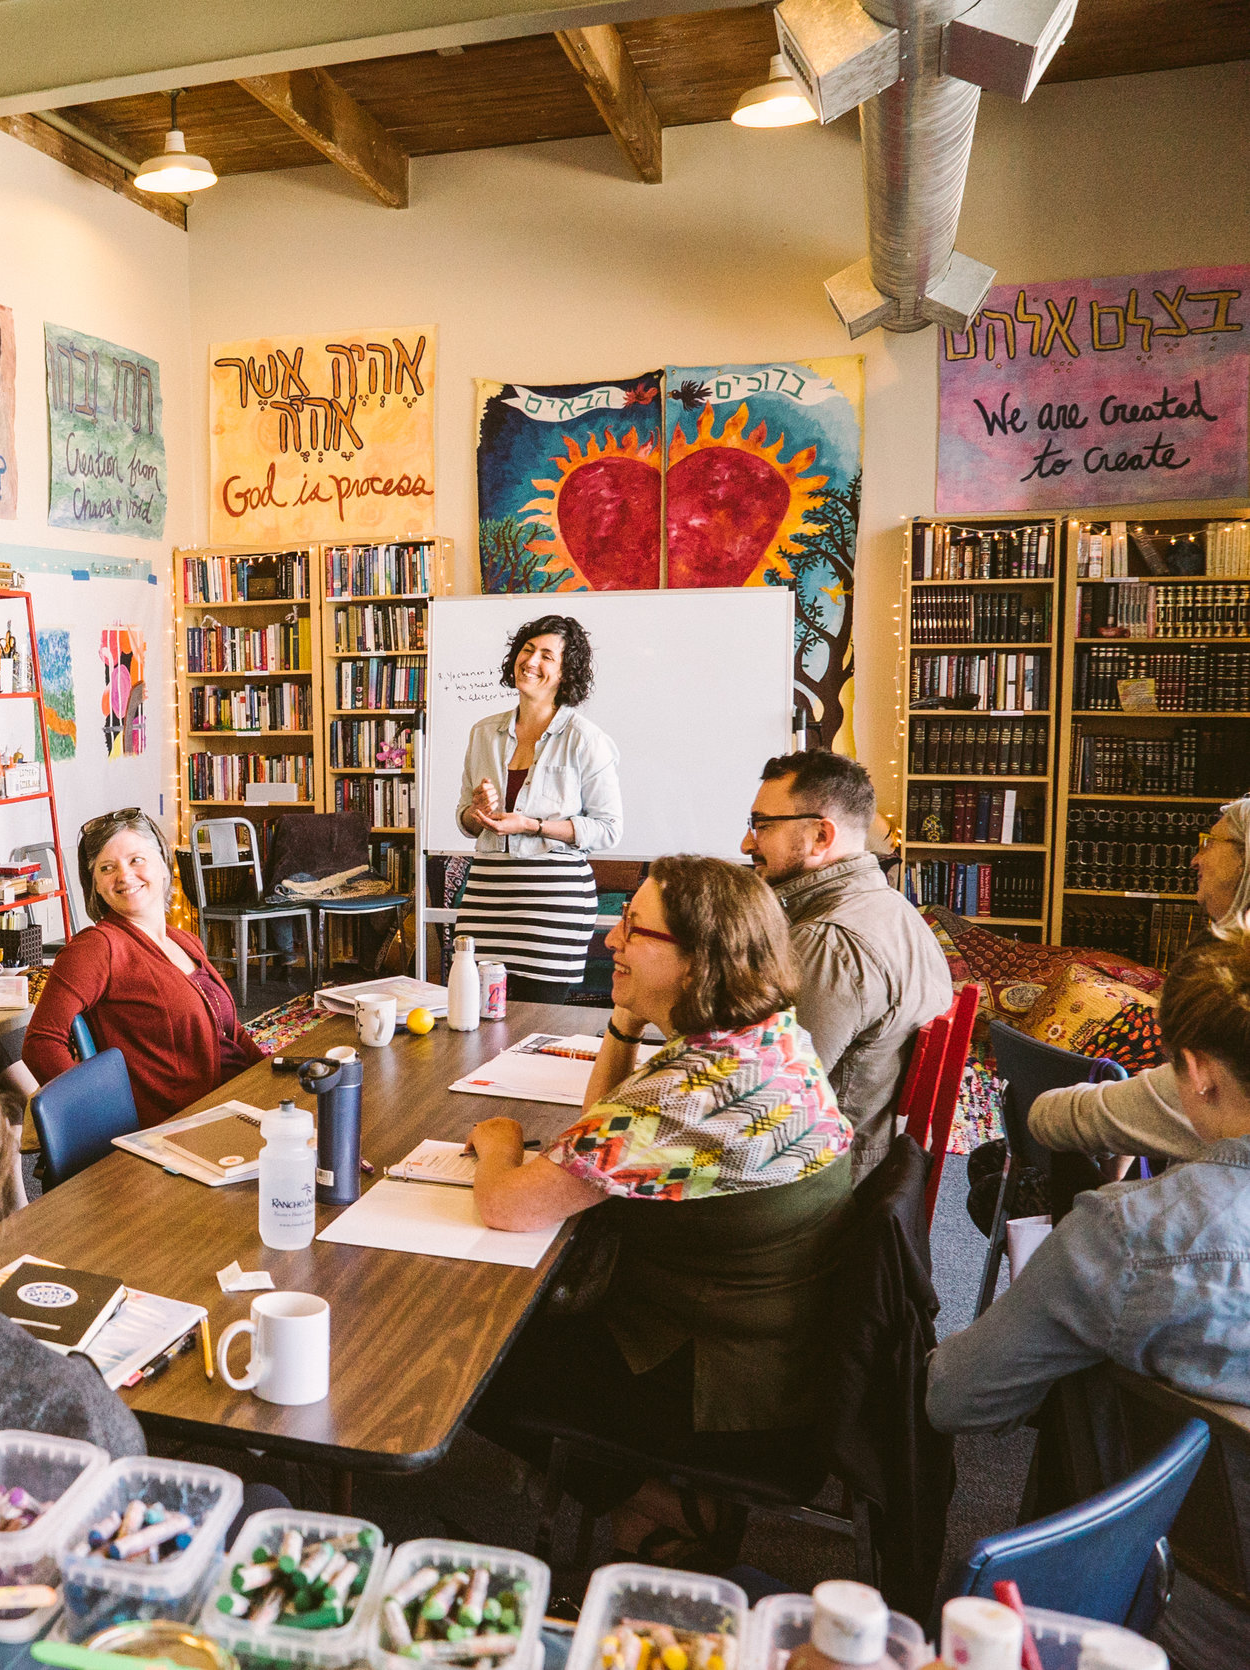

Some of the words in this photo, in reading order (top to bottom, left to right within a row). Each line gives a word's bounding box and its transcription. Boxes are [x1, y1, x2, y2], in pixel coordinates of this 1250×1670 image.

[972, 392, 1028, 436] We
[1037, 402, 1089, 431] are
[66, 432, 124, 483] Creation
[128, 448, 161, 492] from
[1020, 438, 1073, 483] to
[222, 462, 288, 518] God
[292, 474, 333, 508] is
[328, 473, 434, 523] process
[271, 1198, 305, 1209] RANCHO
